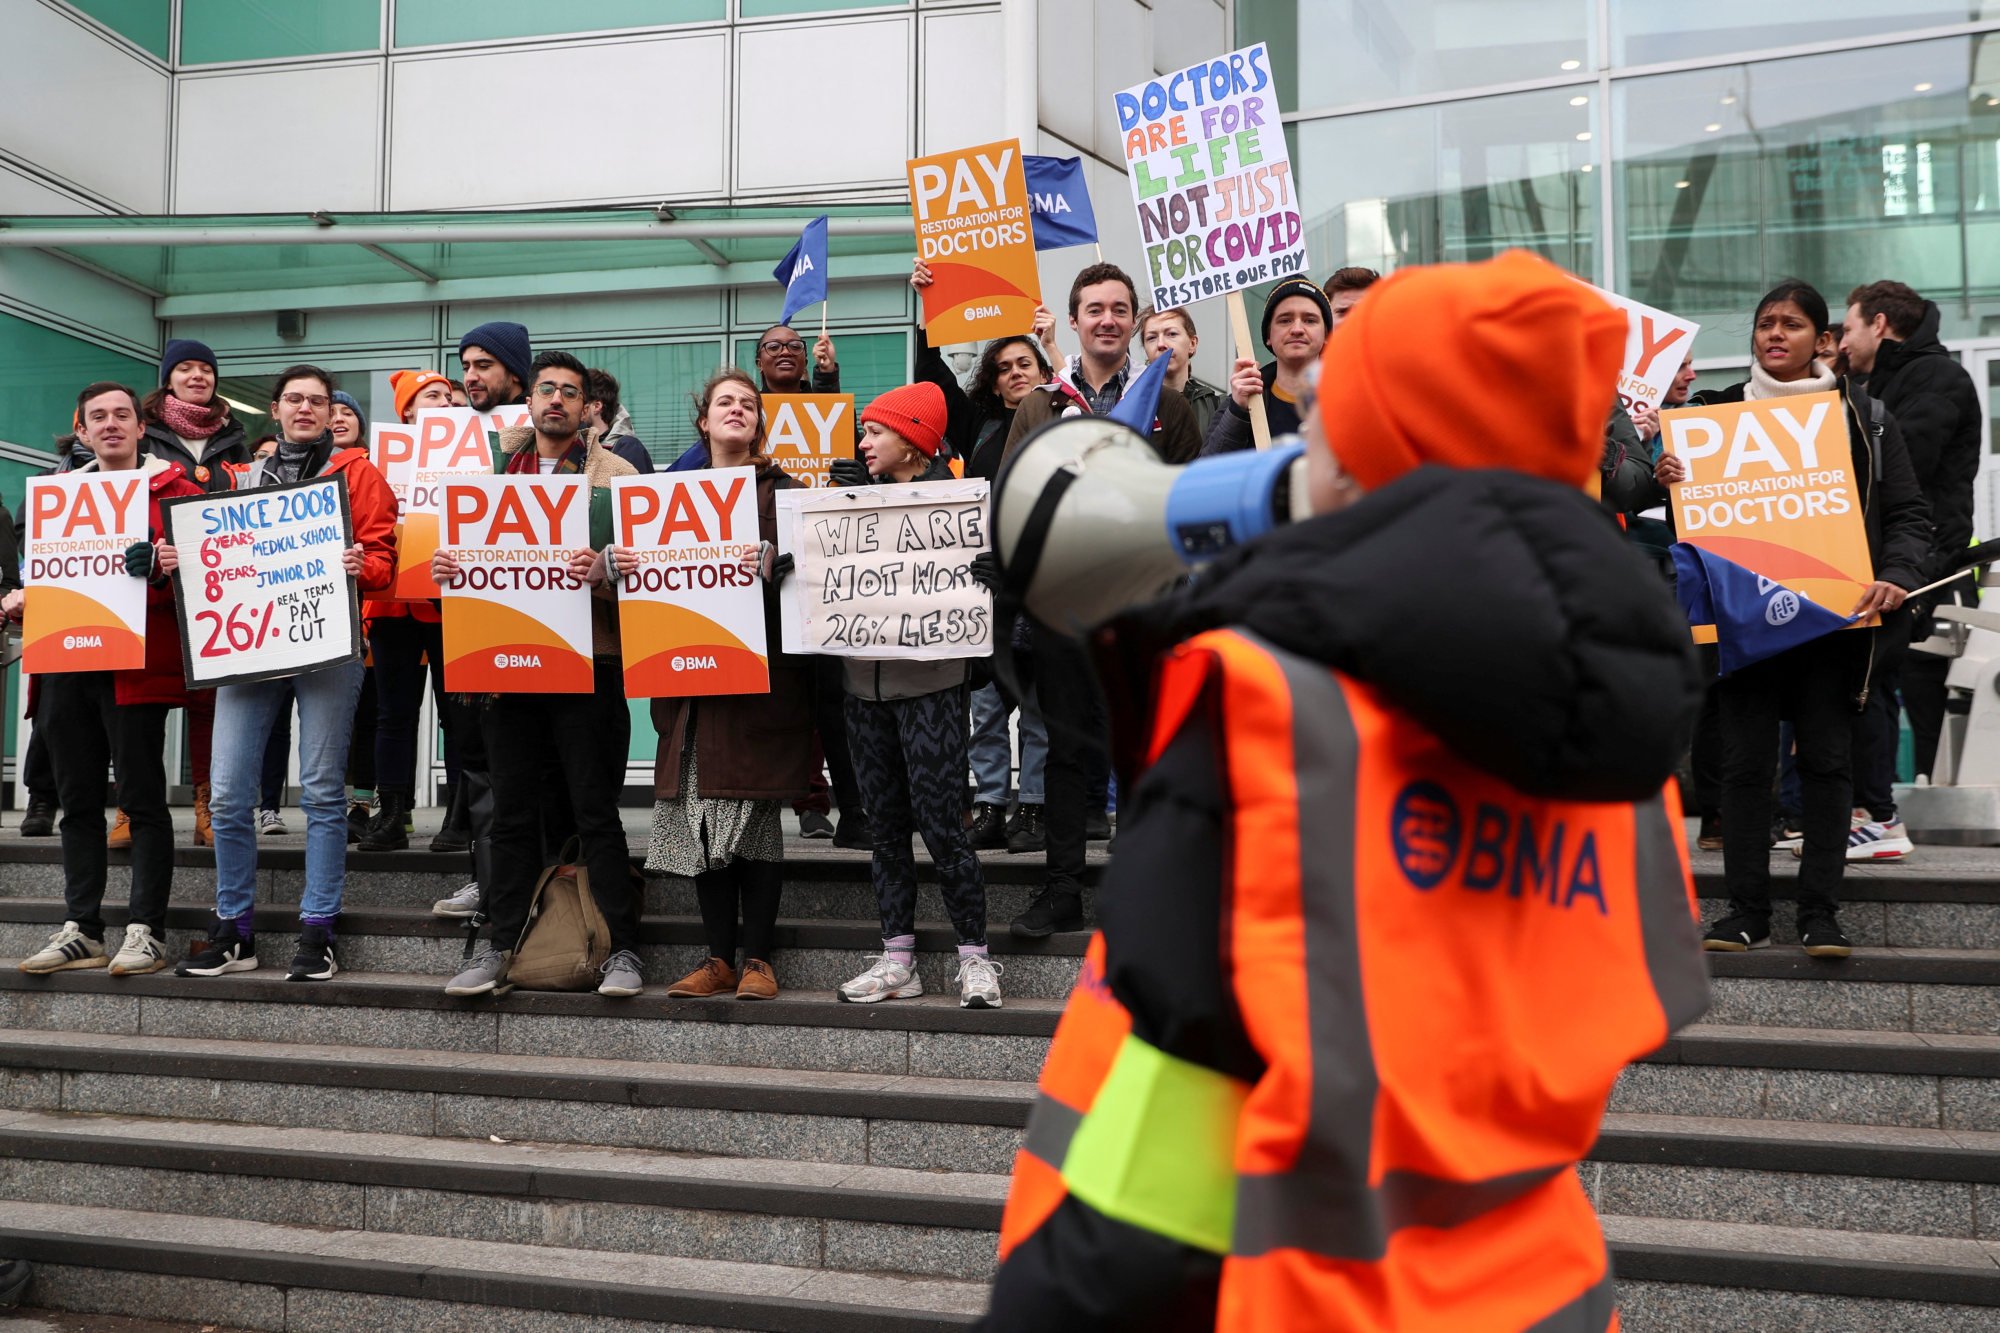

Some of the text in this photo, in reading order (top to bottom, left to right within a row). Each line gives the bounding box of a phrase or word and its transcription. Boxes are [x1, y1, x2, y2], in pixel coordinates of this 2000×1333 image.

[1114, 47, 1268, 132] DOCTORS
[1126, 96, 1266, 160] ARE FOR
[912, 148, 1014, 221] PAY
[1133, 127, 1263, 200] LIFE
[920, 205, 1023, 235] RESTORATION FOR
[1137, 160, 1289, 244] NOT JUST
[922, 221, 1027, 259] DOCTORS
[1146, 211, 1301, 288] FOR COVID
[1154, 249, 1305, 311] RESTORE OUR PAY
[976, 304, 1002, 320] BMA
[1629, 381, 1658, 400] FOR
[762, 402, 847, 455] AY
[1670, 401, 1831, 482] PAY
[1680, 469, 1846, 501] RESTORATION FOR
[32, 479, 141, 540] PAY
[202, 485, 337, 534] SINCE 2008
[446, 485, 579, 545] PAY
[619, 477, 747, 548] PAY
[1682, 488, 1851, 531] DOCTORS
[31, 539, 114, 555] RESTORATION
[200, 525, 341, 569] 6 YEARS MEDICAL SCHOOL
[814, 506, 984, 558] WE ARE
[31, 554, 126, 580] DOCTOR
[634, 547, 720, 565] ESTORATION
[204, 558, 327, 603] 8 YEARS JUNIOR DR
[277, 582, 335, 606] REAL TERMS
[449, 566, 583, 590] DOCTORS
[624, 563, 754, 594] DOCTORS
[823, 562, 904, 605] NOT
[195, 600, 281, 658] 26%
[288, 617, 326, 643] CUT
[290, 598, 321, 622] PAY
[821, 606, 988, 648] 26% LESS
[75, 636, 102, 649] BMA
[509, 654, 542, 668] BMA
[686, 656, 718, 670] BMA
[1463, 806, 1607, 912] BMA
